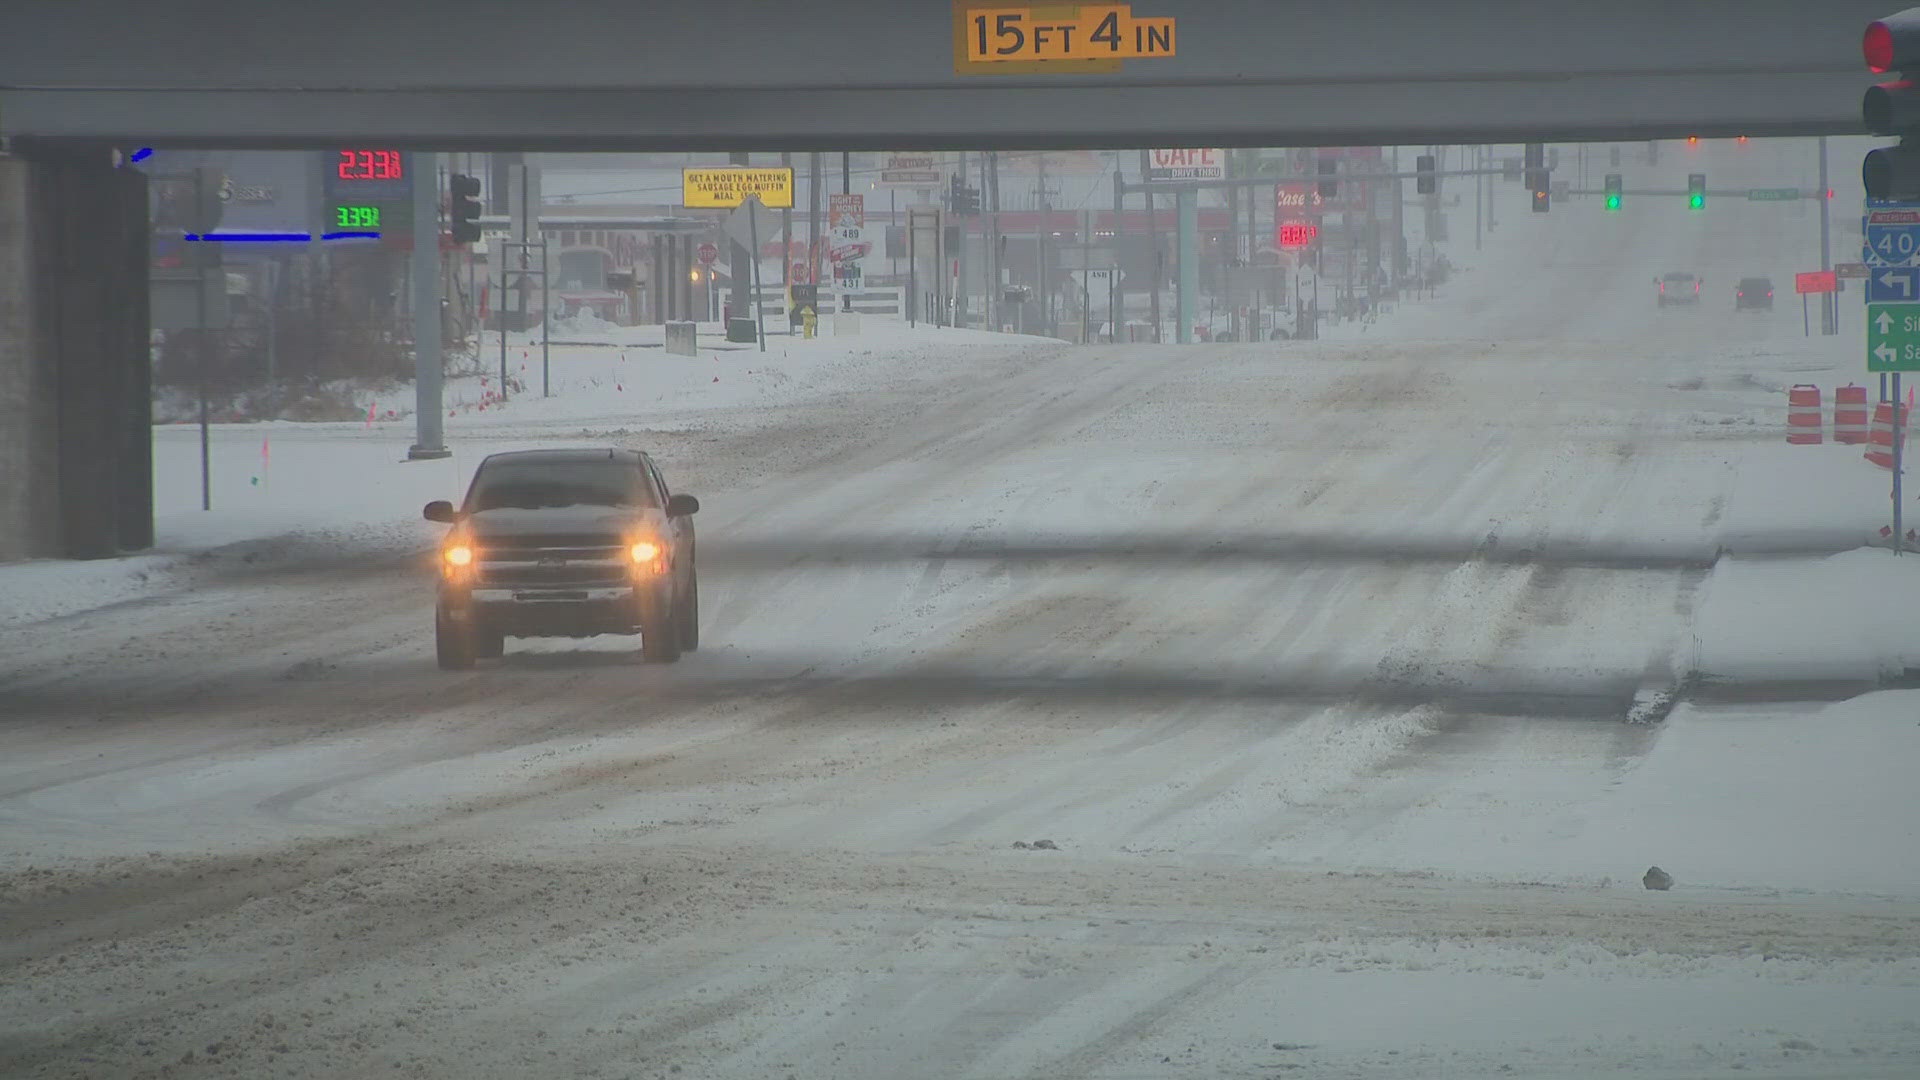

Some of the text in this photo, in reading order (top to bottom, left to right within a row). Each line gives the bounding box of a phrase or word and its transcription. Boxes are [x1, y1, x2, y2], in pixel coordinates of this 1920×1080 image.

[974, 11, 1170, 55] 15 FT 4 IN
[1172, 168, 1220, 177] DRIVE THRU
[688, 173, 787, 183] GET A MOUTH WATERING
[697, 183, 784, 191] SAUSAGE EGG MUFFIN
[713, 191, 734, 200] MEAL
[1878, 233, 1913, 253] 40
